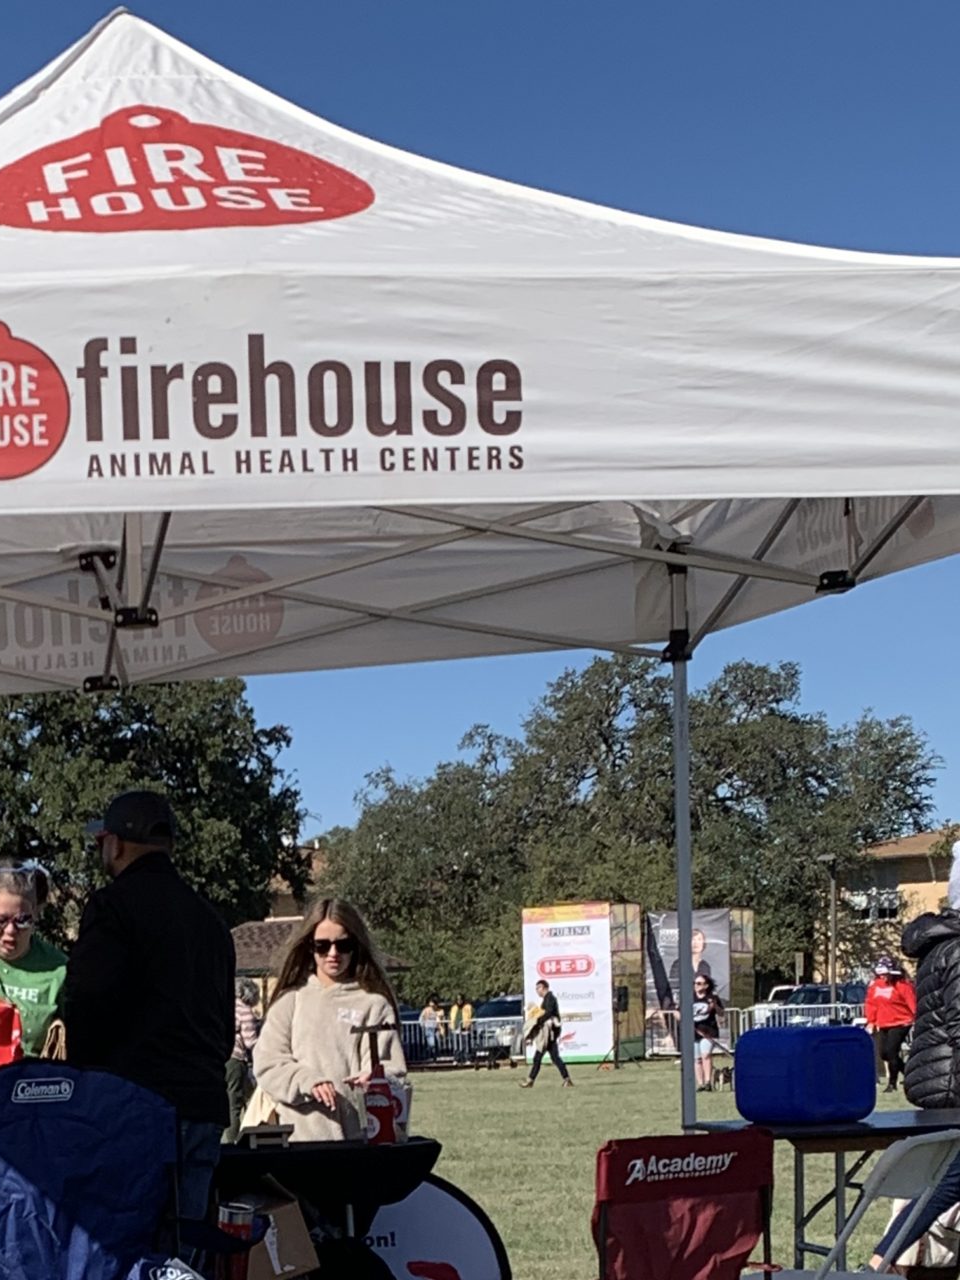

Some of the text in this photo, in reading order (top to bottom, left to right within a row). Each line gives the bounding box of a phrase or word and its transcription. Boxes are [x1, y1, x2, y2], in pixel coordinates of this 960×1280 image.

[42, 142, 281, 194] FIRE
[26, 186, 325, 223] HOUSE
[76, 333, 523, 442] firehouse
[86, 444, 525, 479] ANIMAL HEALTH CENTERS
[550, 925, 591, 937] PURINA
[4, 984, 39, 1003] THE
[17, 1082, 59, 1097] Coleman
[647, 1151, 733, 1175] Academy
